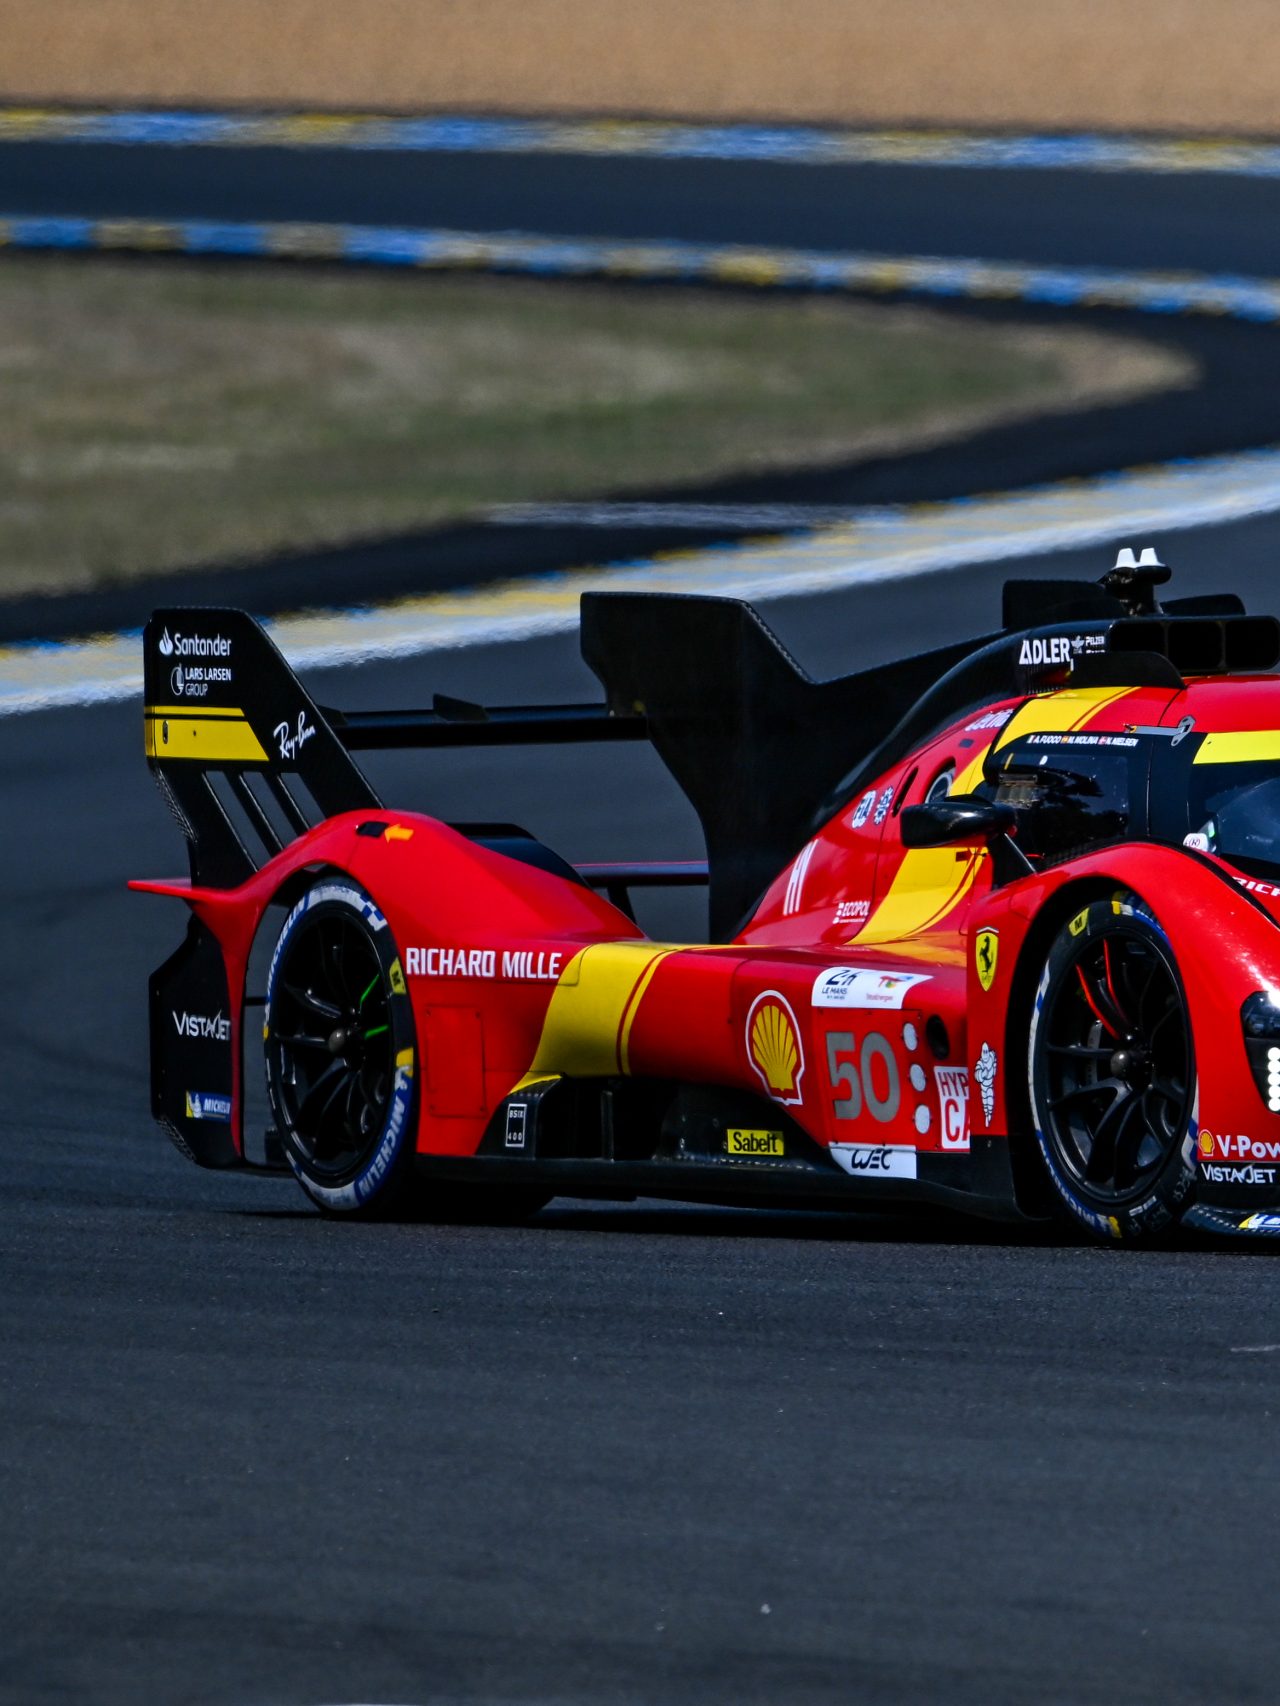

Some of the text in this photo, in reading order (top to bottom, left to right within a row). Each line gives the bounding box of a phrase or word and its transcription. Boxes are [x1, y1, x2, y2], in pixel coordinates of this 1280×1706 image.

[174, 633, 232, 656] Santander
[1018, 637, 1071, 665] ADLER
[185, 667, 232, 682] LARS LARSEN
[185, 683, 208, 696] GROUP
[273, 710, 316, 760] Ray-Ban
[405, 946, 563, 980] RICHARD MILLE
[825, 1031, 901, 1123] 50
[357, 1095, 405, 1197] MICHELIN
[733, 1131, 777, 1154] Sabelt
[850, 1149, 893, 1170] WEC
